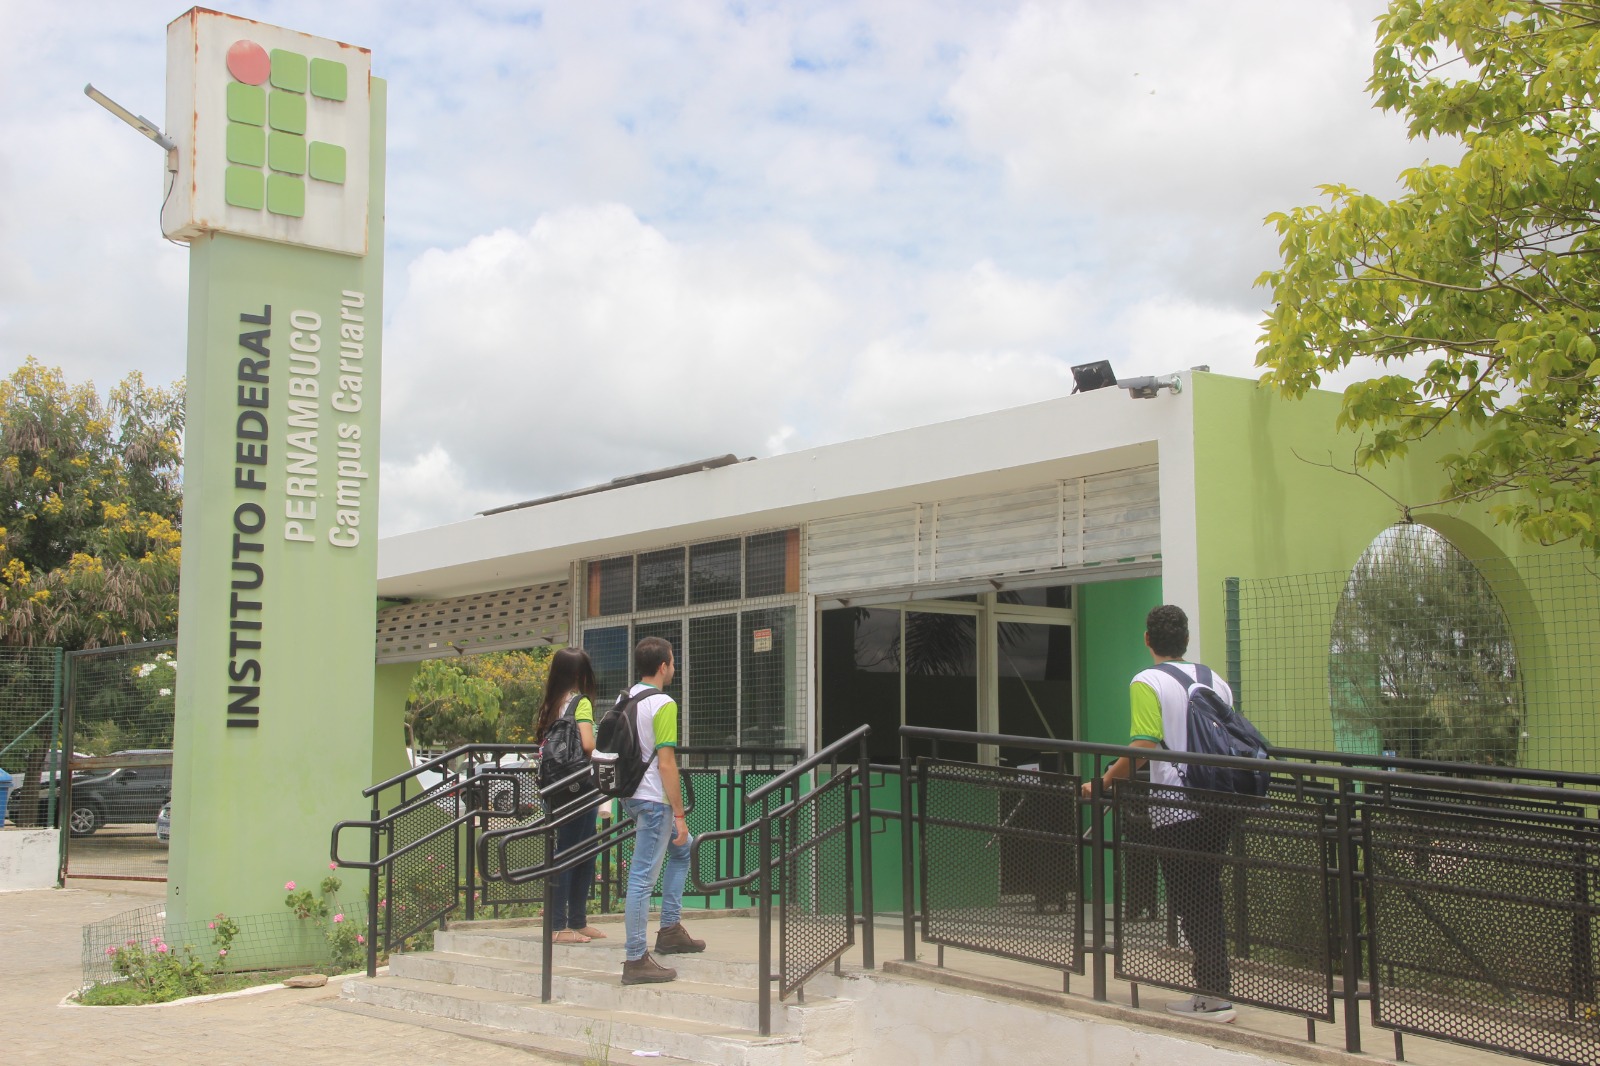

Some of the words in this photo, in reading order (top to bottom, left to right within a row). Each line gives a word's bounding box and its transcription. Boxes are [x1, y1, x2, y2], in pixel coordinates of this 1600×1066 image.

[234, 304, 272, 492] FEDERAL
[284, 309, 322, 542] PERNAMBUCO
[331, 289, 365, 413] Caruaru
[328, 422, 369, 549] Campus
[226, 502, 268, 730] INSTITUTO
